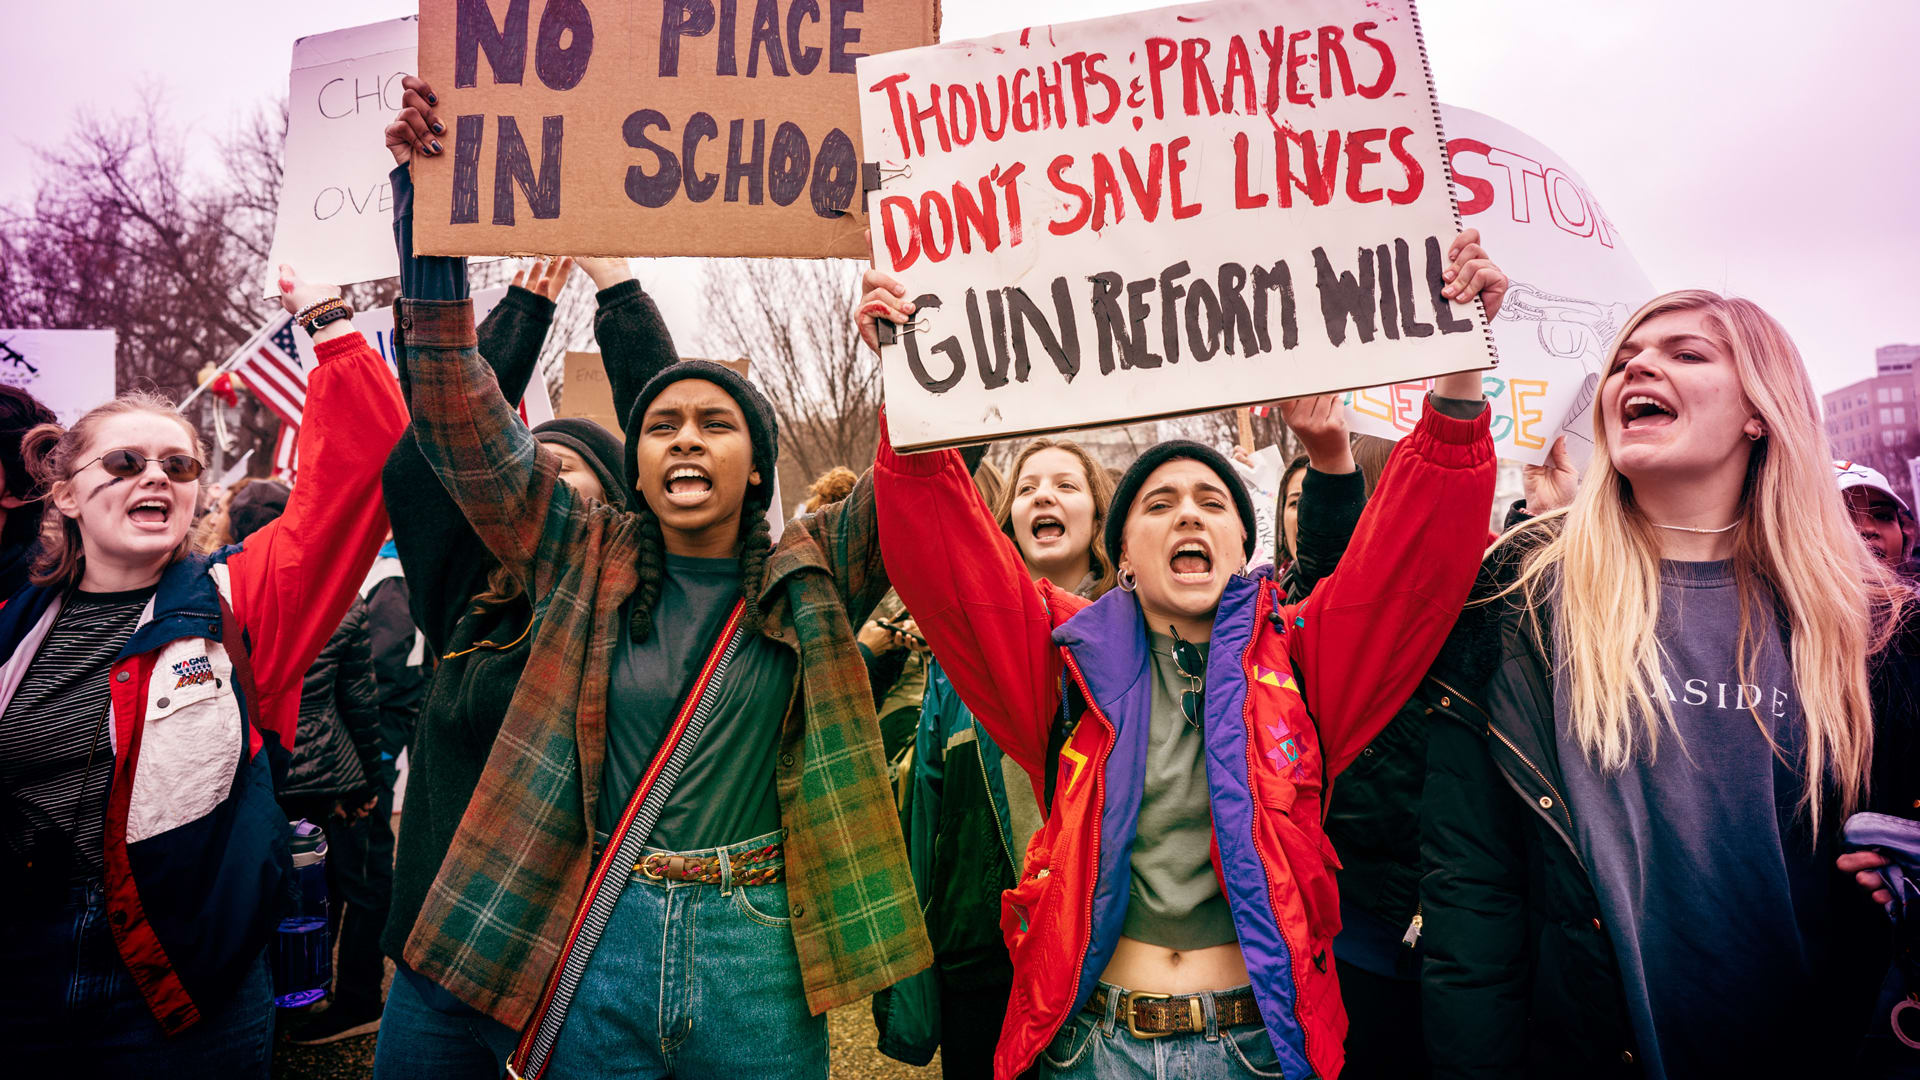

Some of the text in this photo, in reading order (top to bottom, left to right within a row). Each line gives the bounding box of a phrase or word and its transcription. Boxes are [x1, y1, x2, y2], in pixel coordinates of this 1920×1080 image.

[455, 0, 594, 91] NO
[869, 51, 1121, 160] THOUGHTS
[1145, 21, 1397, 120] PRAYERS
[450, 109, 868, 226] IN SCHOO
[881, 126, 1425, 272] DON'T SAVE LIVES
[903, 236, 1473, 395] GUN REFORM WILL
